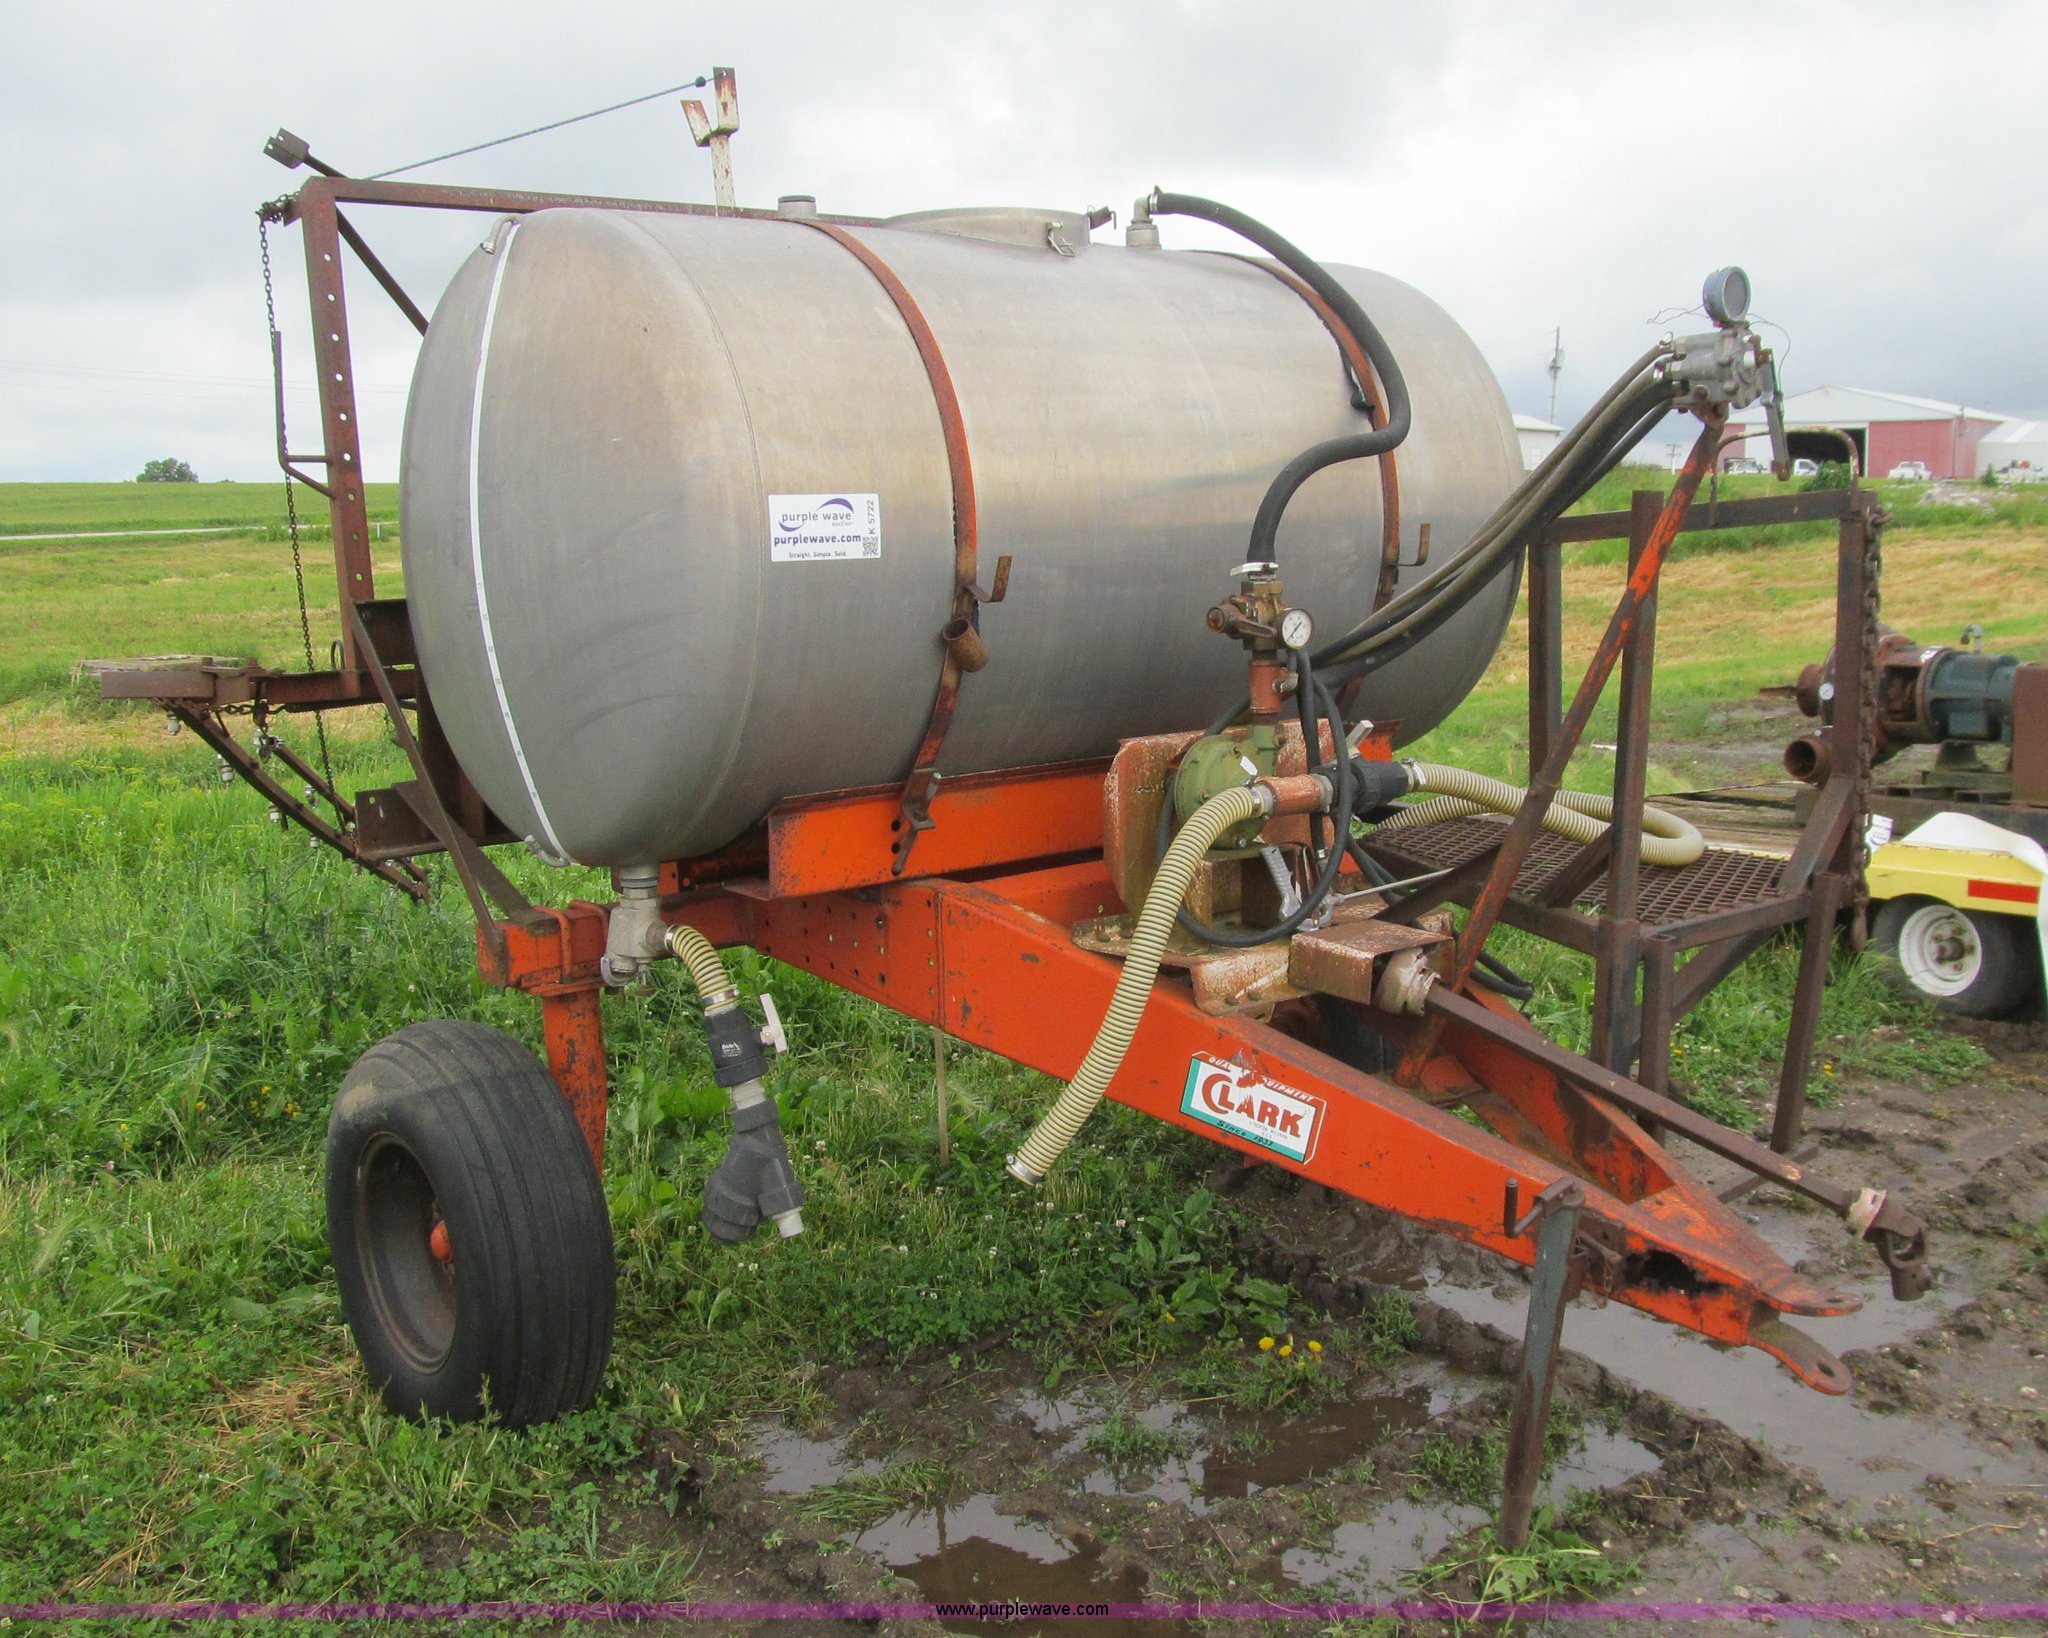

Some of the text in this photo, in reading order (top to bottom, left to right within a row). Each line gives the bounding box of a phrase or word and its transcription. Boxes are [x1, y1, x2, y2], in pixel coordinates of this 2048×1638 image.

[782, 511, 852, 523] purple wave
[867, 500, 875, 524] 5722
[774, 533, 861, 547] purplewave.com
[1202, 1073, 1303, 1138] CLARK
[1217, 1120, 1247, 1137] Since
[1254, 1135, 1274, 1147] 1937
